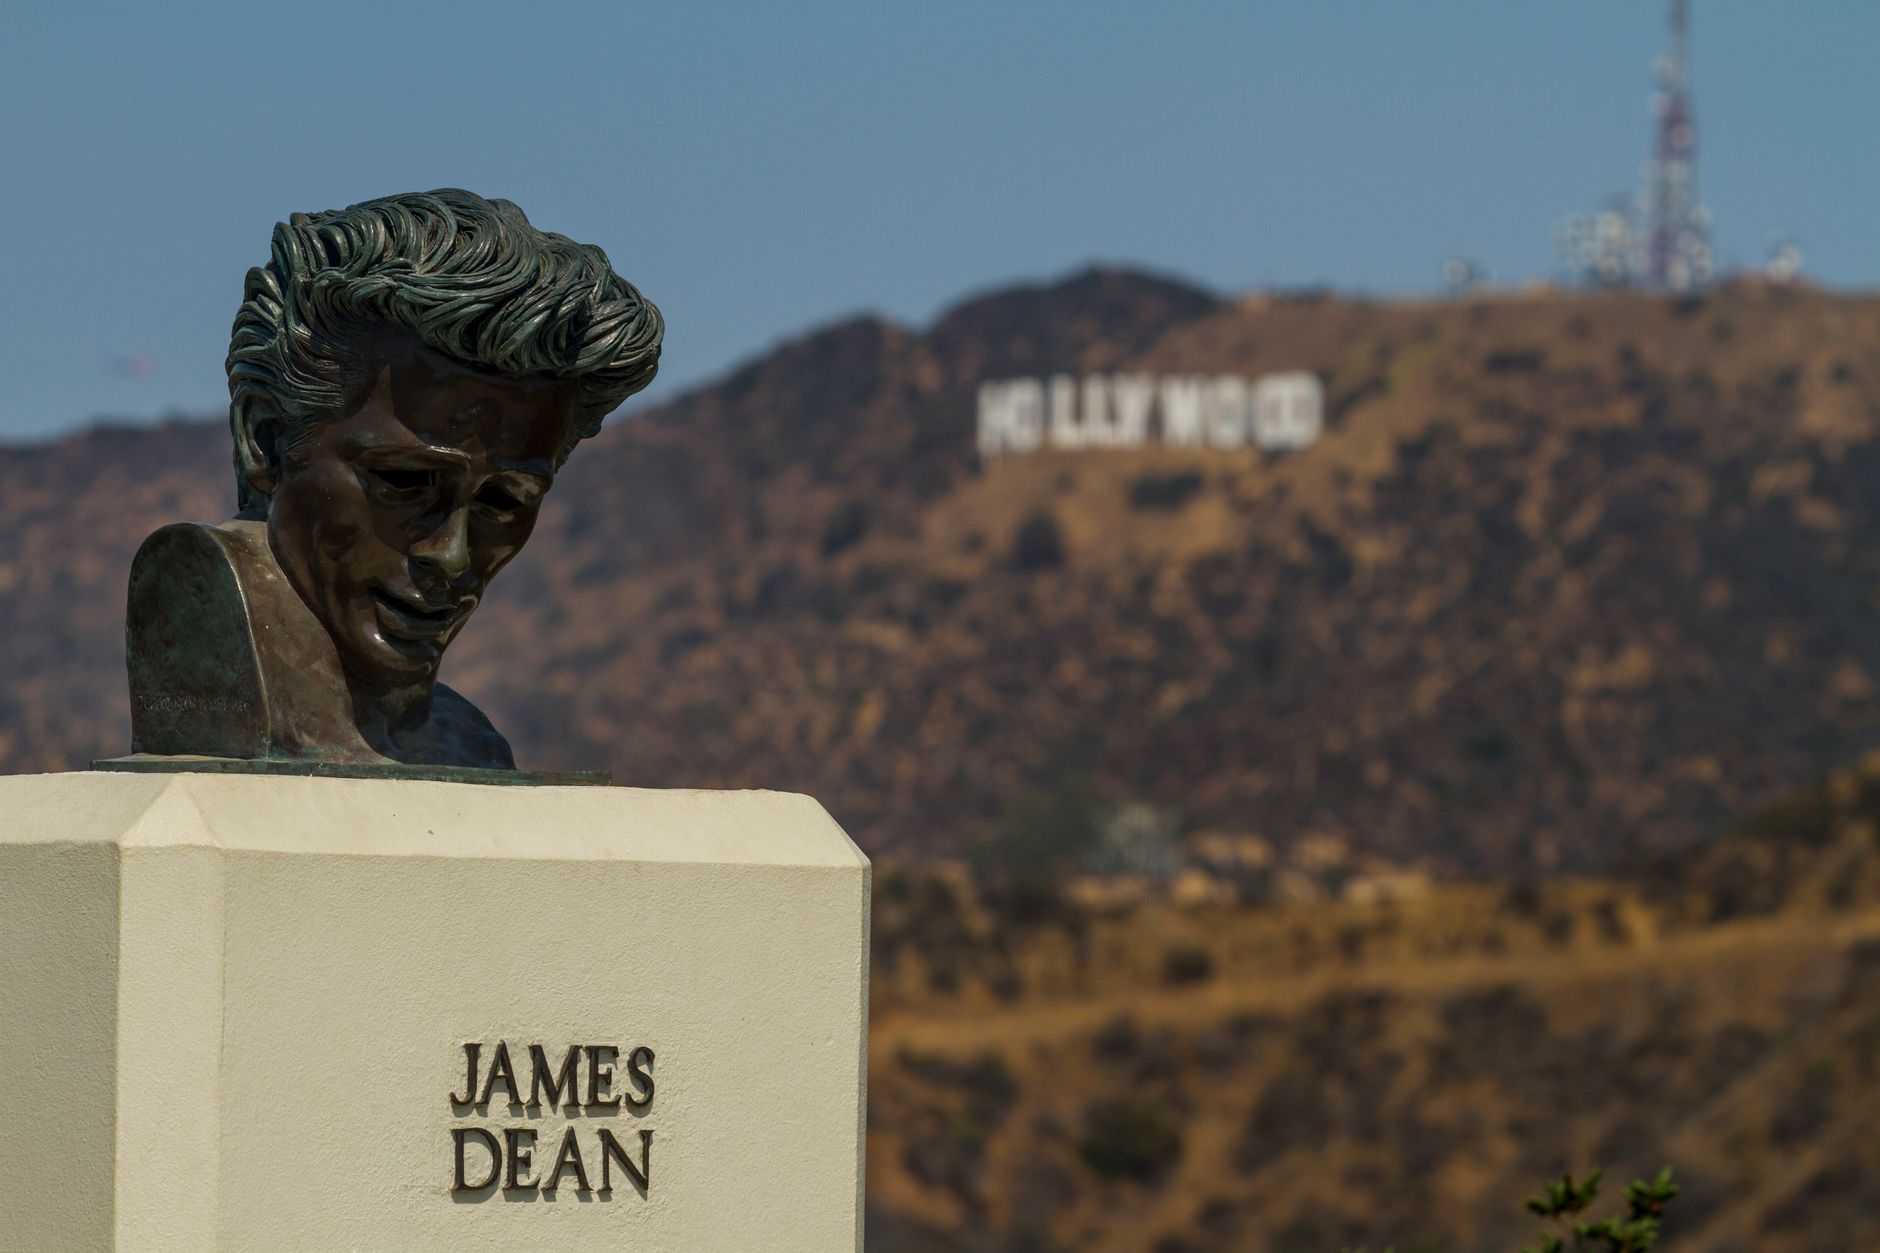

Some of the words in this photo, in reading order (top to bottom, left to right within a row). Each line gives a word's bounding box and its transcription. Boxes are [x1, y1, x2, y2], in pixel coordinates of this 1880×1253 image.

[977, 369, 1325, 456] HOLLYWOOD
[449, 1039, 656, 1109] JAMES
[449, 1125, 656, 1198] DEAN
